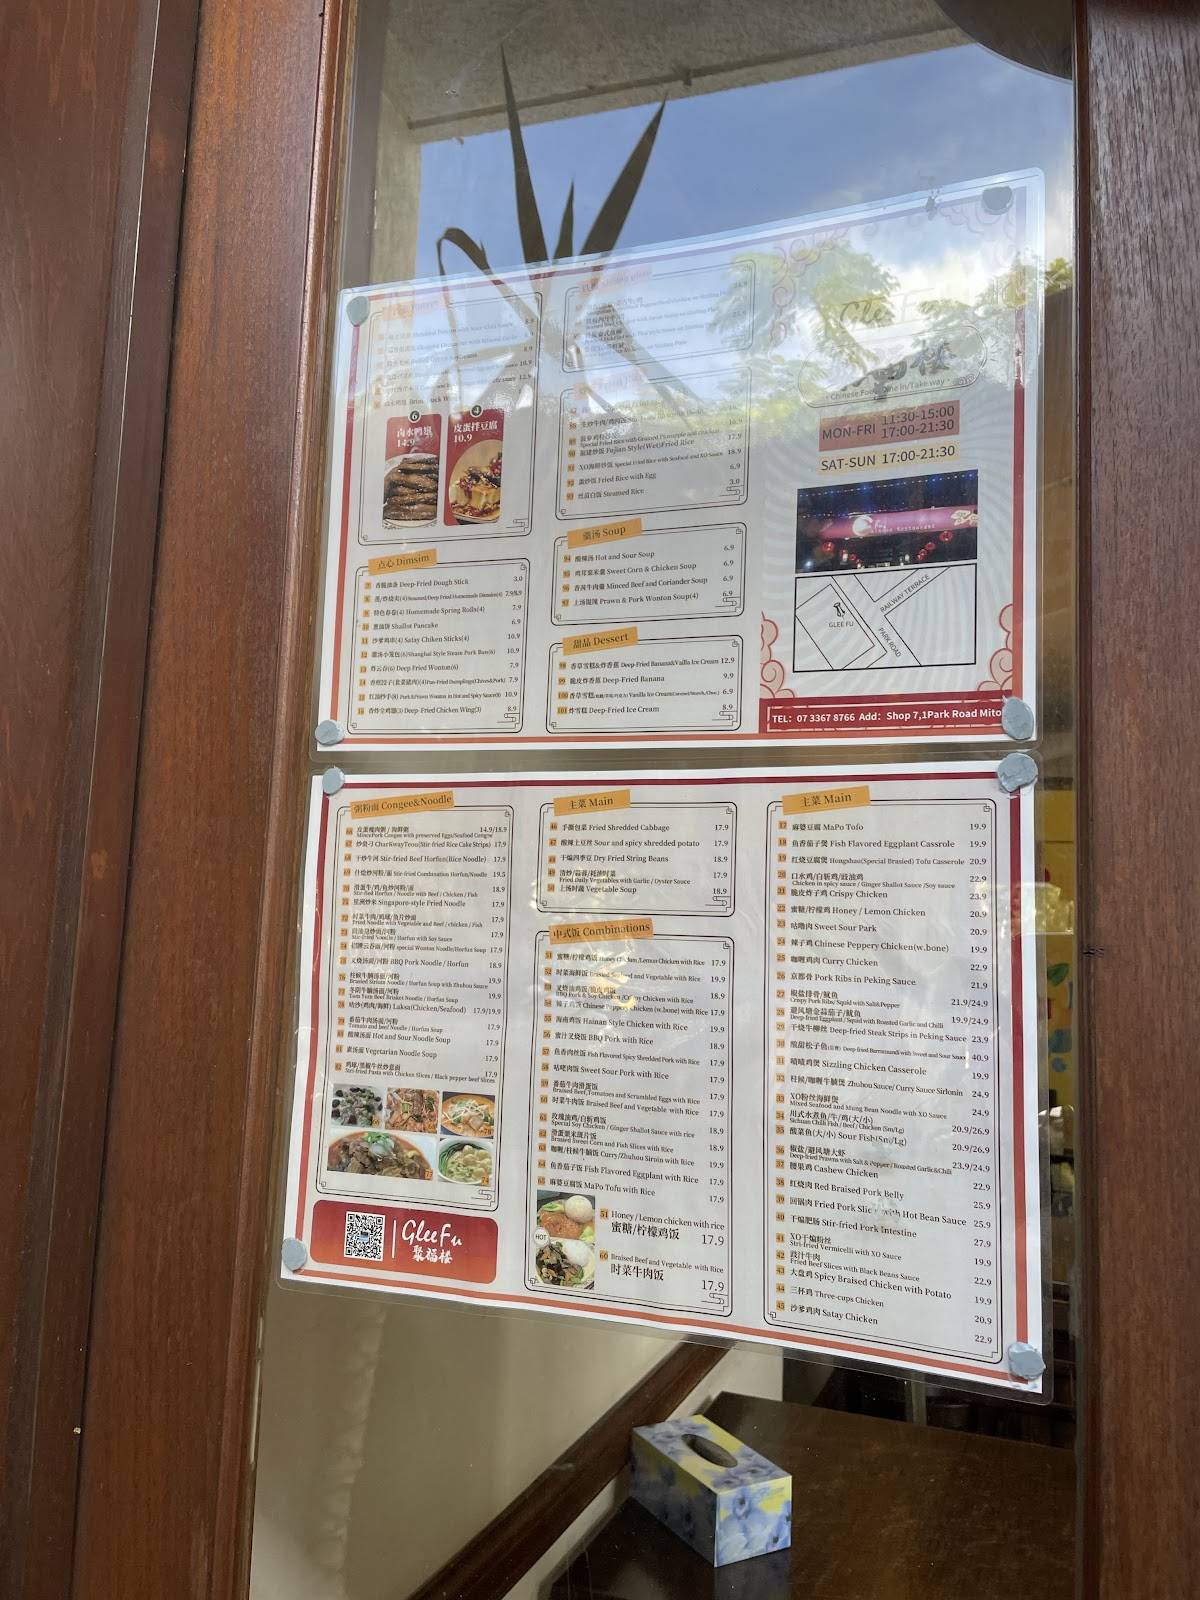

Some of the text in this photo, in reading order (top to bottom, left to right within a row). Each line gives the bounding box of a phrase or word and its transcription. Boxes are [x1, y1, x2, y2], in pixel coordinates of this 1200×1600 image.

[882, 406, 954, 425] 11:30-15:00
[822, 424, 876, 440] MON-FRI
[881, 420, 954, 439] 17:00-21:30
[821, 446, 955, 471] SAT-SUN 17:00-21:30
[603, 526, 626, 537] Soup
[593, 633, 629, 646] Dessert
[796, 714, 808, 723] 07
[810, 713, 831, 722] 3367
[833, 713, 855, 722] 8766
[886, 711, 911, 721] Shop
[952, 709, 977, 719] Road
[589, 797, 614, 807] Main
[824, 794, 852, 804] Main
[640, 824, 670, 832] Cabbage
[594, 839, 610, 847] Sour
[625, 840, 642, 848] spicy
[677, 840, 700, 848] potato
[848, 840, 882, 848] Flavored
[884, 840, 918, 849] Eggplant
[594, 855, 606, 863] Dry
[626, 855, 647, 863] String
[830, 890, 854, 899] Crispy
[855, 890, 888, 899] Chicken
[864, 976, 890, 985] Peking
[892, 978, 916, 986] Sauce
[853, 1063, 886, 1072] Chicken
[972, 1072, 989, 1080] 19.9
[611, 1211, 633, 1221] Honey
[639, 1214, 663, 1223] Lemon
[664, 1217, 692, 1226] chicken
[693, 1220, 709, 1228] with
[710, 1222, 725, 1230] rice
[702, 1235, 724, 1245] 17.9
[610, 1264, 664, 1281] 时菜牛肉饭
[701, 1280, 724, 1291] 17.9
[869, 1280, 902, 1291] Chicken
[904, 1285, 923, 1295] with
[975, 1296, 992, 1305] 19.9
